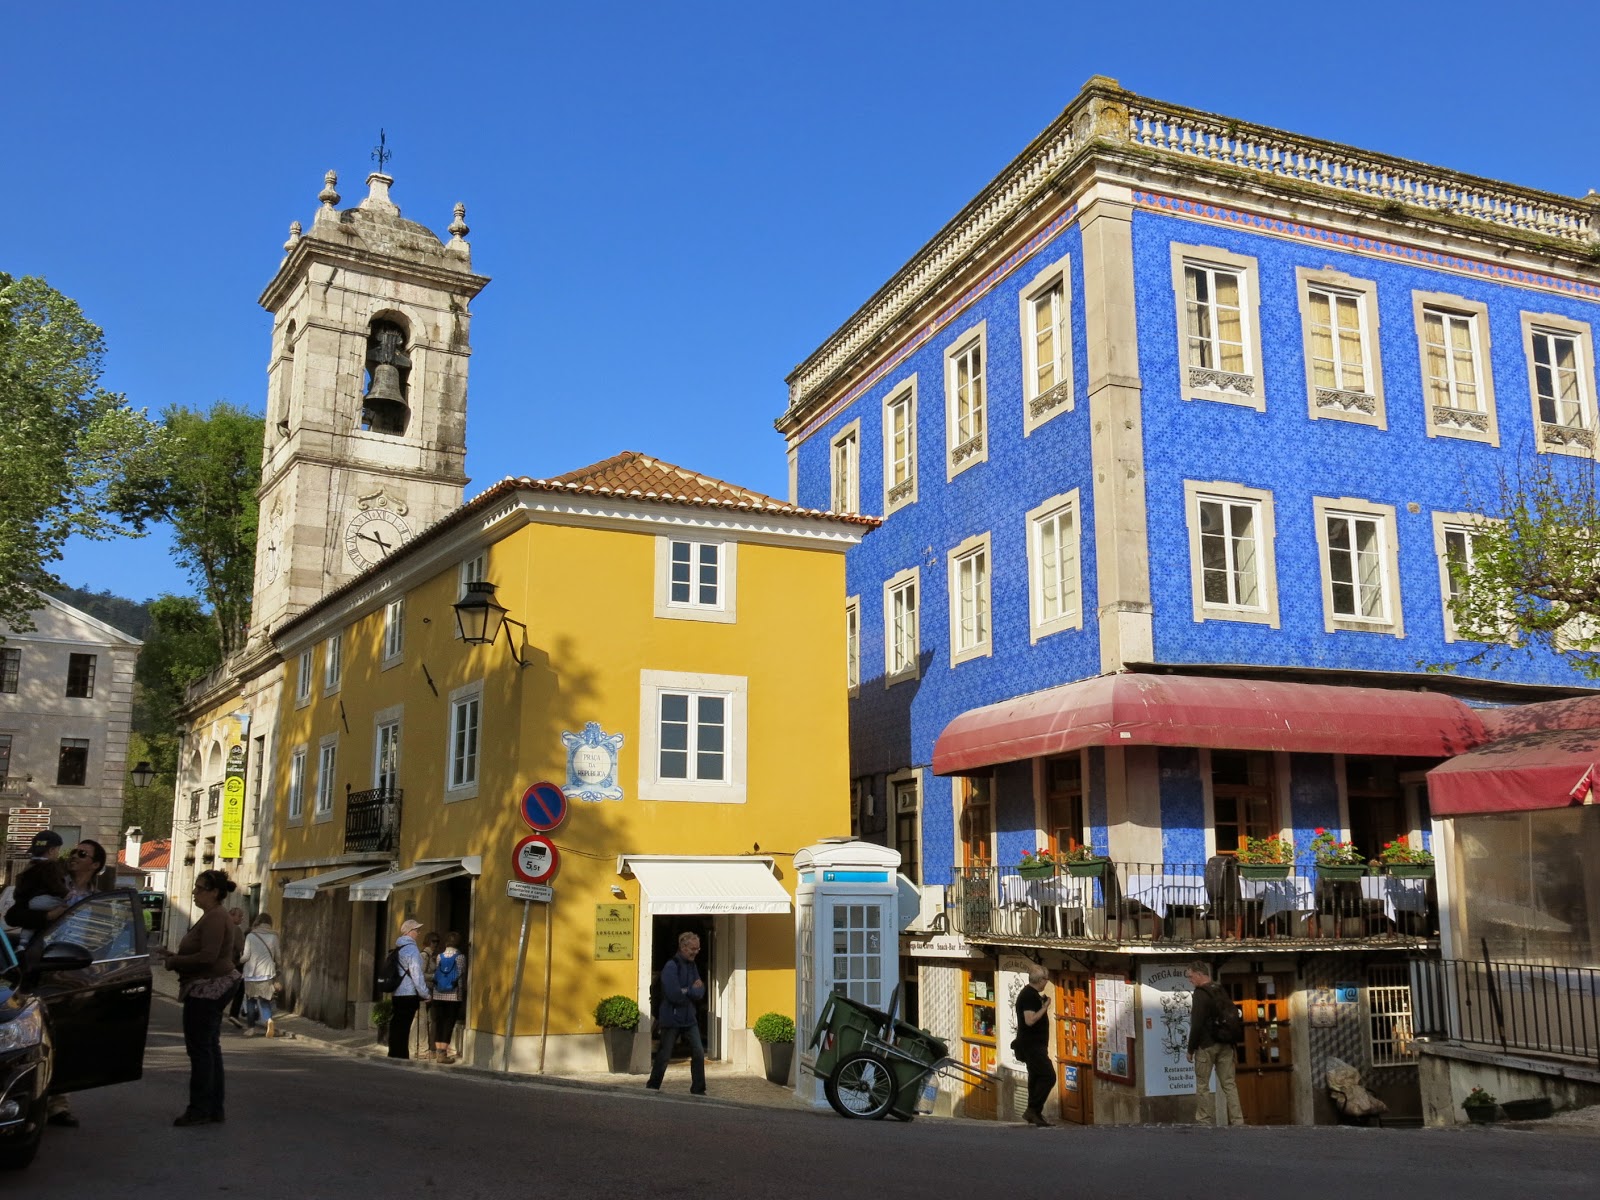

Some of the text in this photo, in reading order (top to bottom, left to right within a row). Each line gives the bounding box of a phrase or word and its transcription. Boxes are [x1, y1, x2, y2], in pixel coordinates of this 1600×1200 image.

[584, 754, 600, 762] PRAÇA
[526, 861, 540, 871] 5,5t
[937, 942, 956, 950] Snack-Bar
[1148, 970, 1172, 986] ADEGA
[1173, 969, 1182, 977] das
